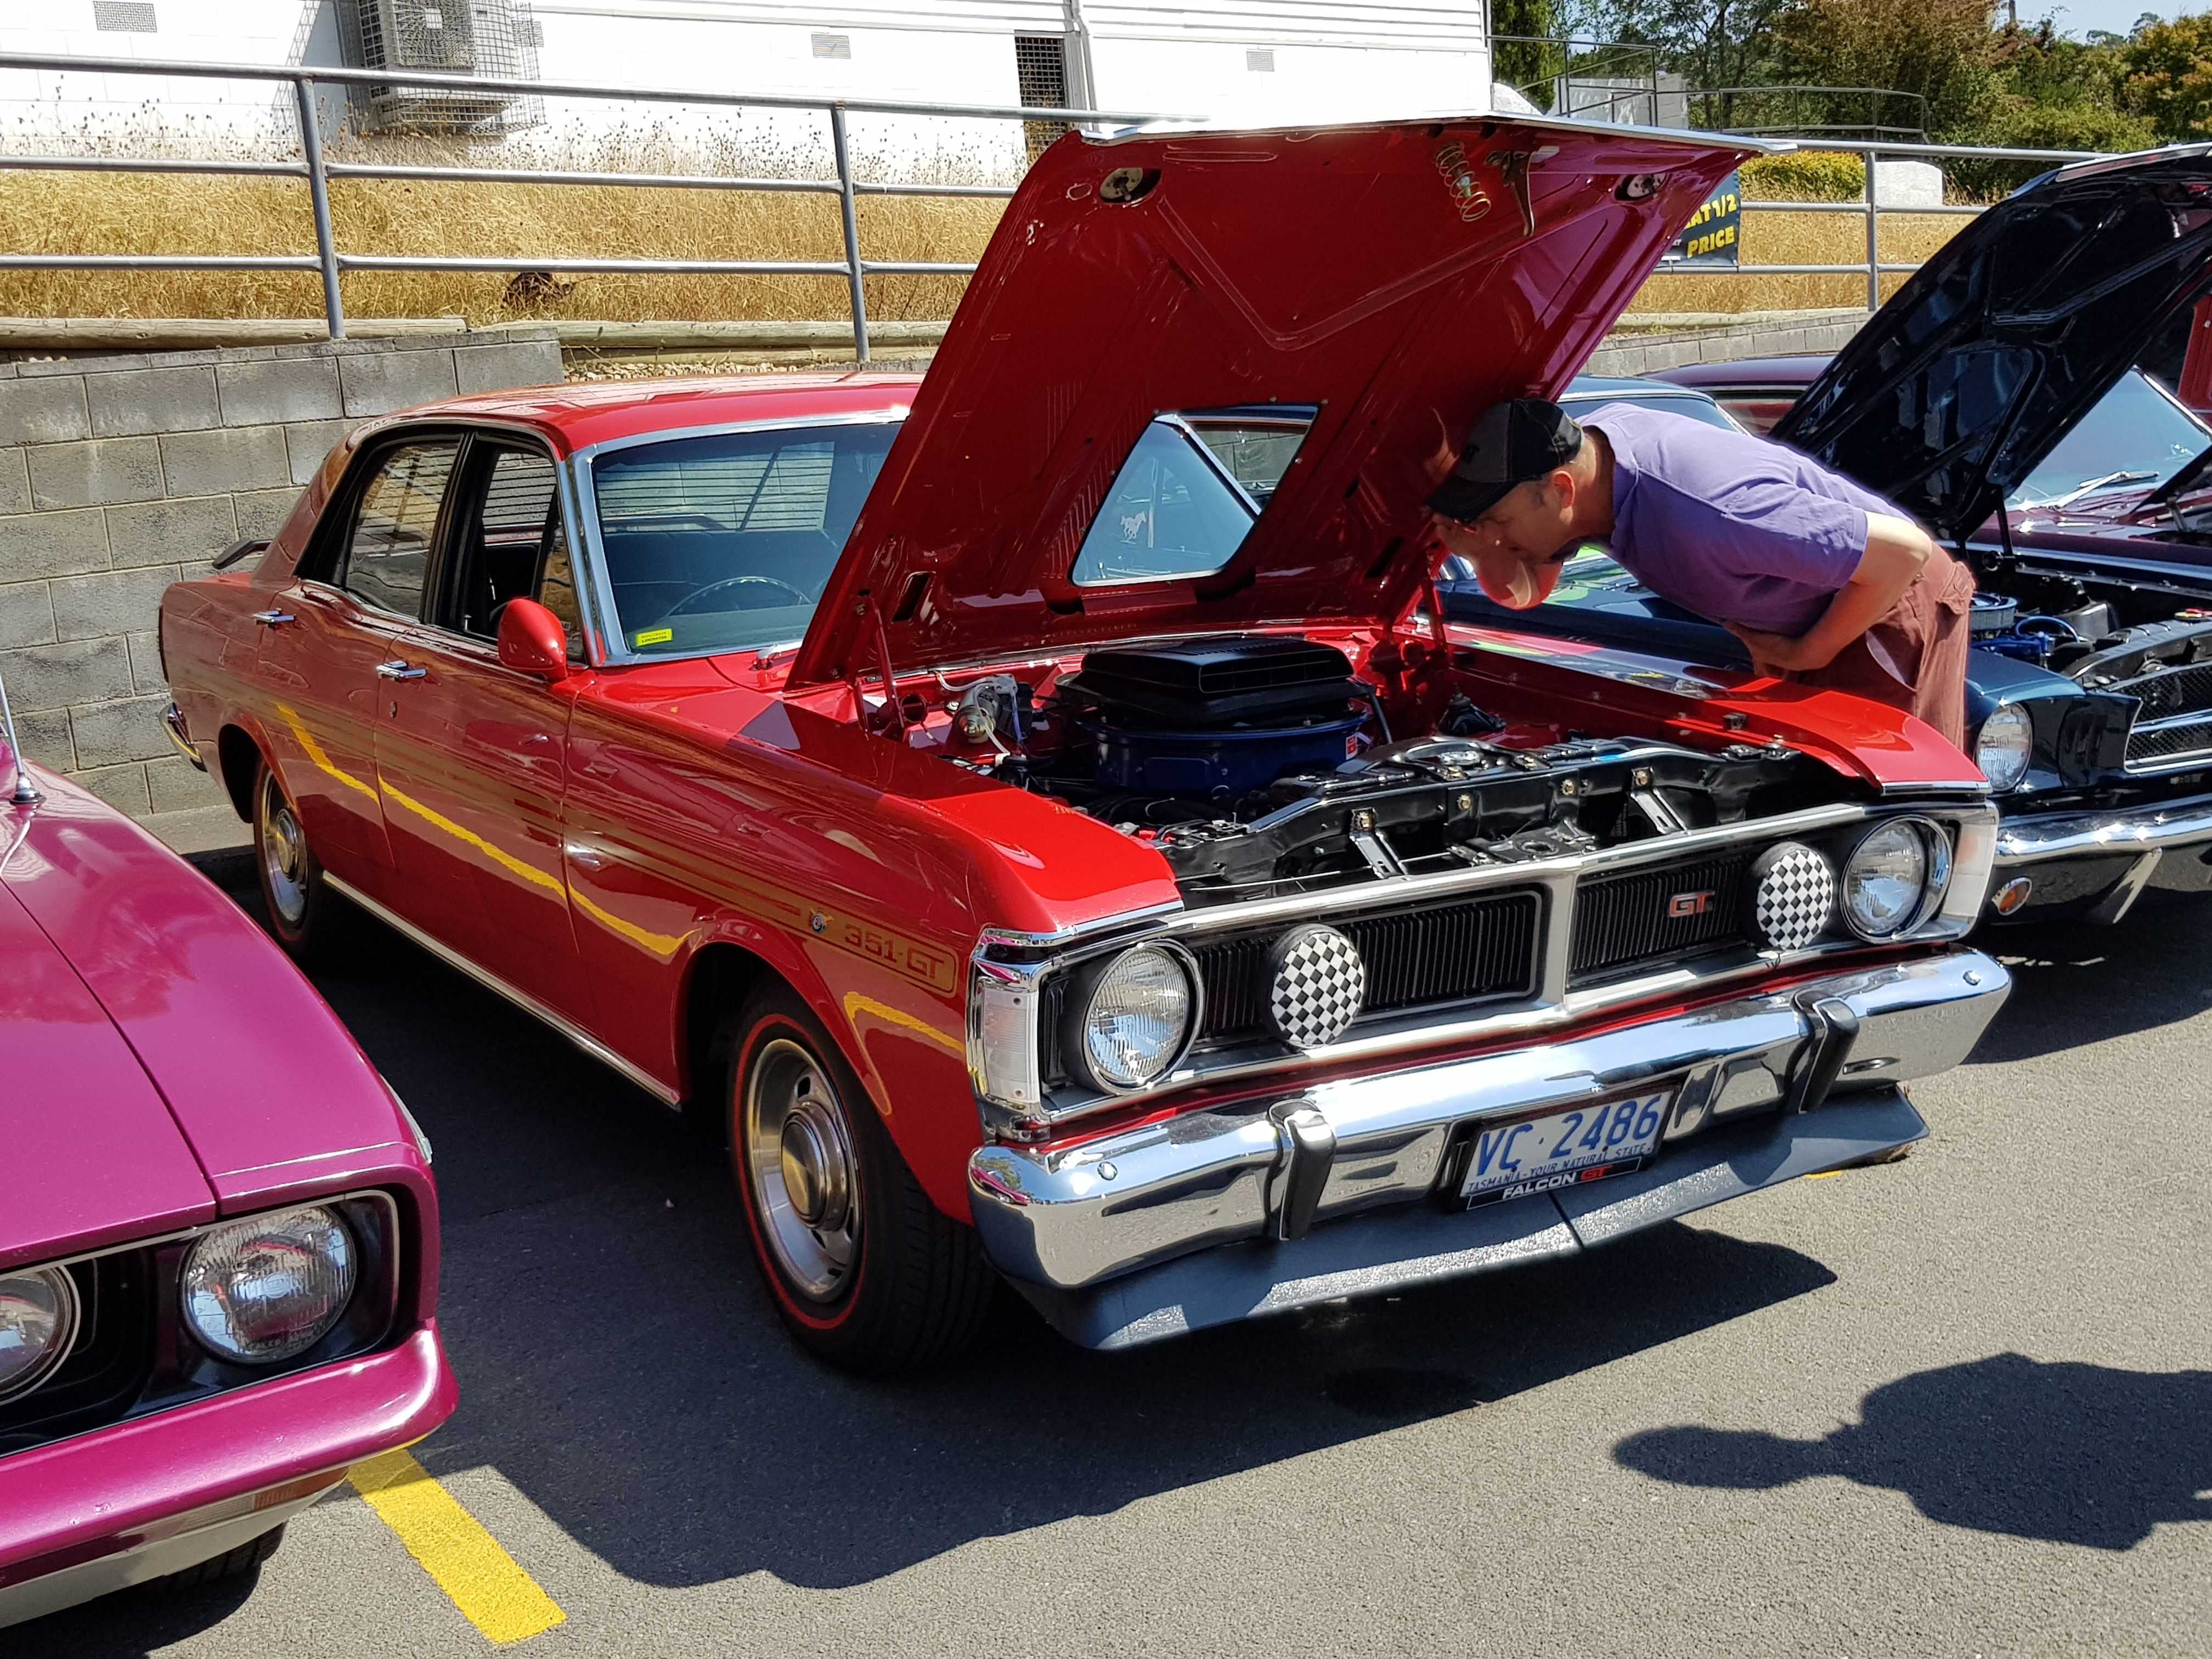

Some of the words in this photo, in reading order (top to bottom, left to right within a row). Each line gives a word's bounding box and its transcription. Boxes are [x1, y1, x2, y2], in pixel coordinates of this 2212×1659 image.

[1712, 194, 1737, 217] 1/2
[1687, 226, 1735, 258] PRICE
[1669, 891, 1715, 917] GT
[1477, 1124, 1533, 1176] VC
[1549, 1097, 1661, 1159] 2486
[1531, 1163, 1558, 1178] YOUR
[1562, 1150, 1608, 1170] NATURAL
[1502, 1171, 1577, 1200] FALCON
[1580, 1164, 1613, 1181] GT
